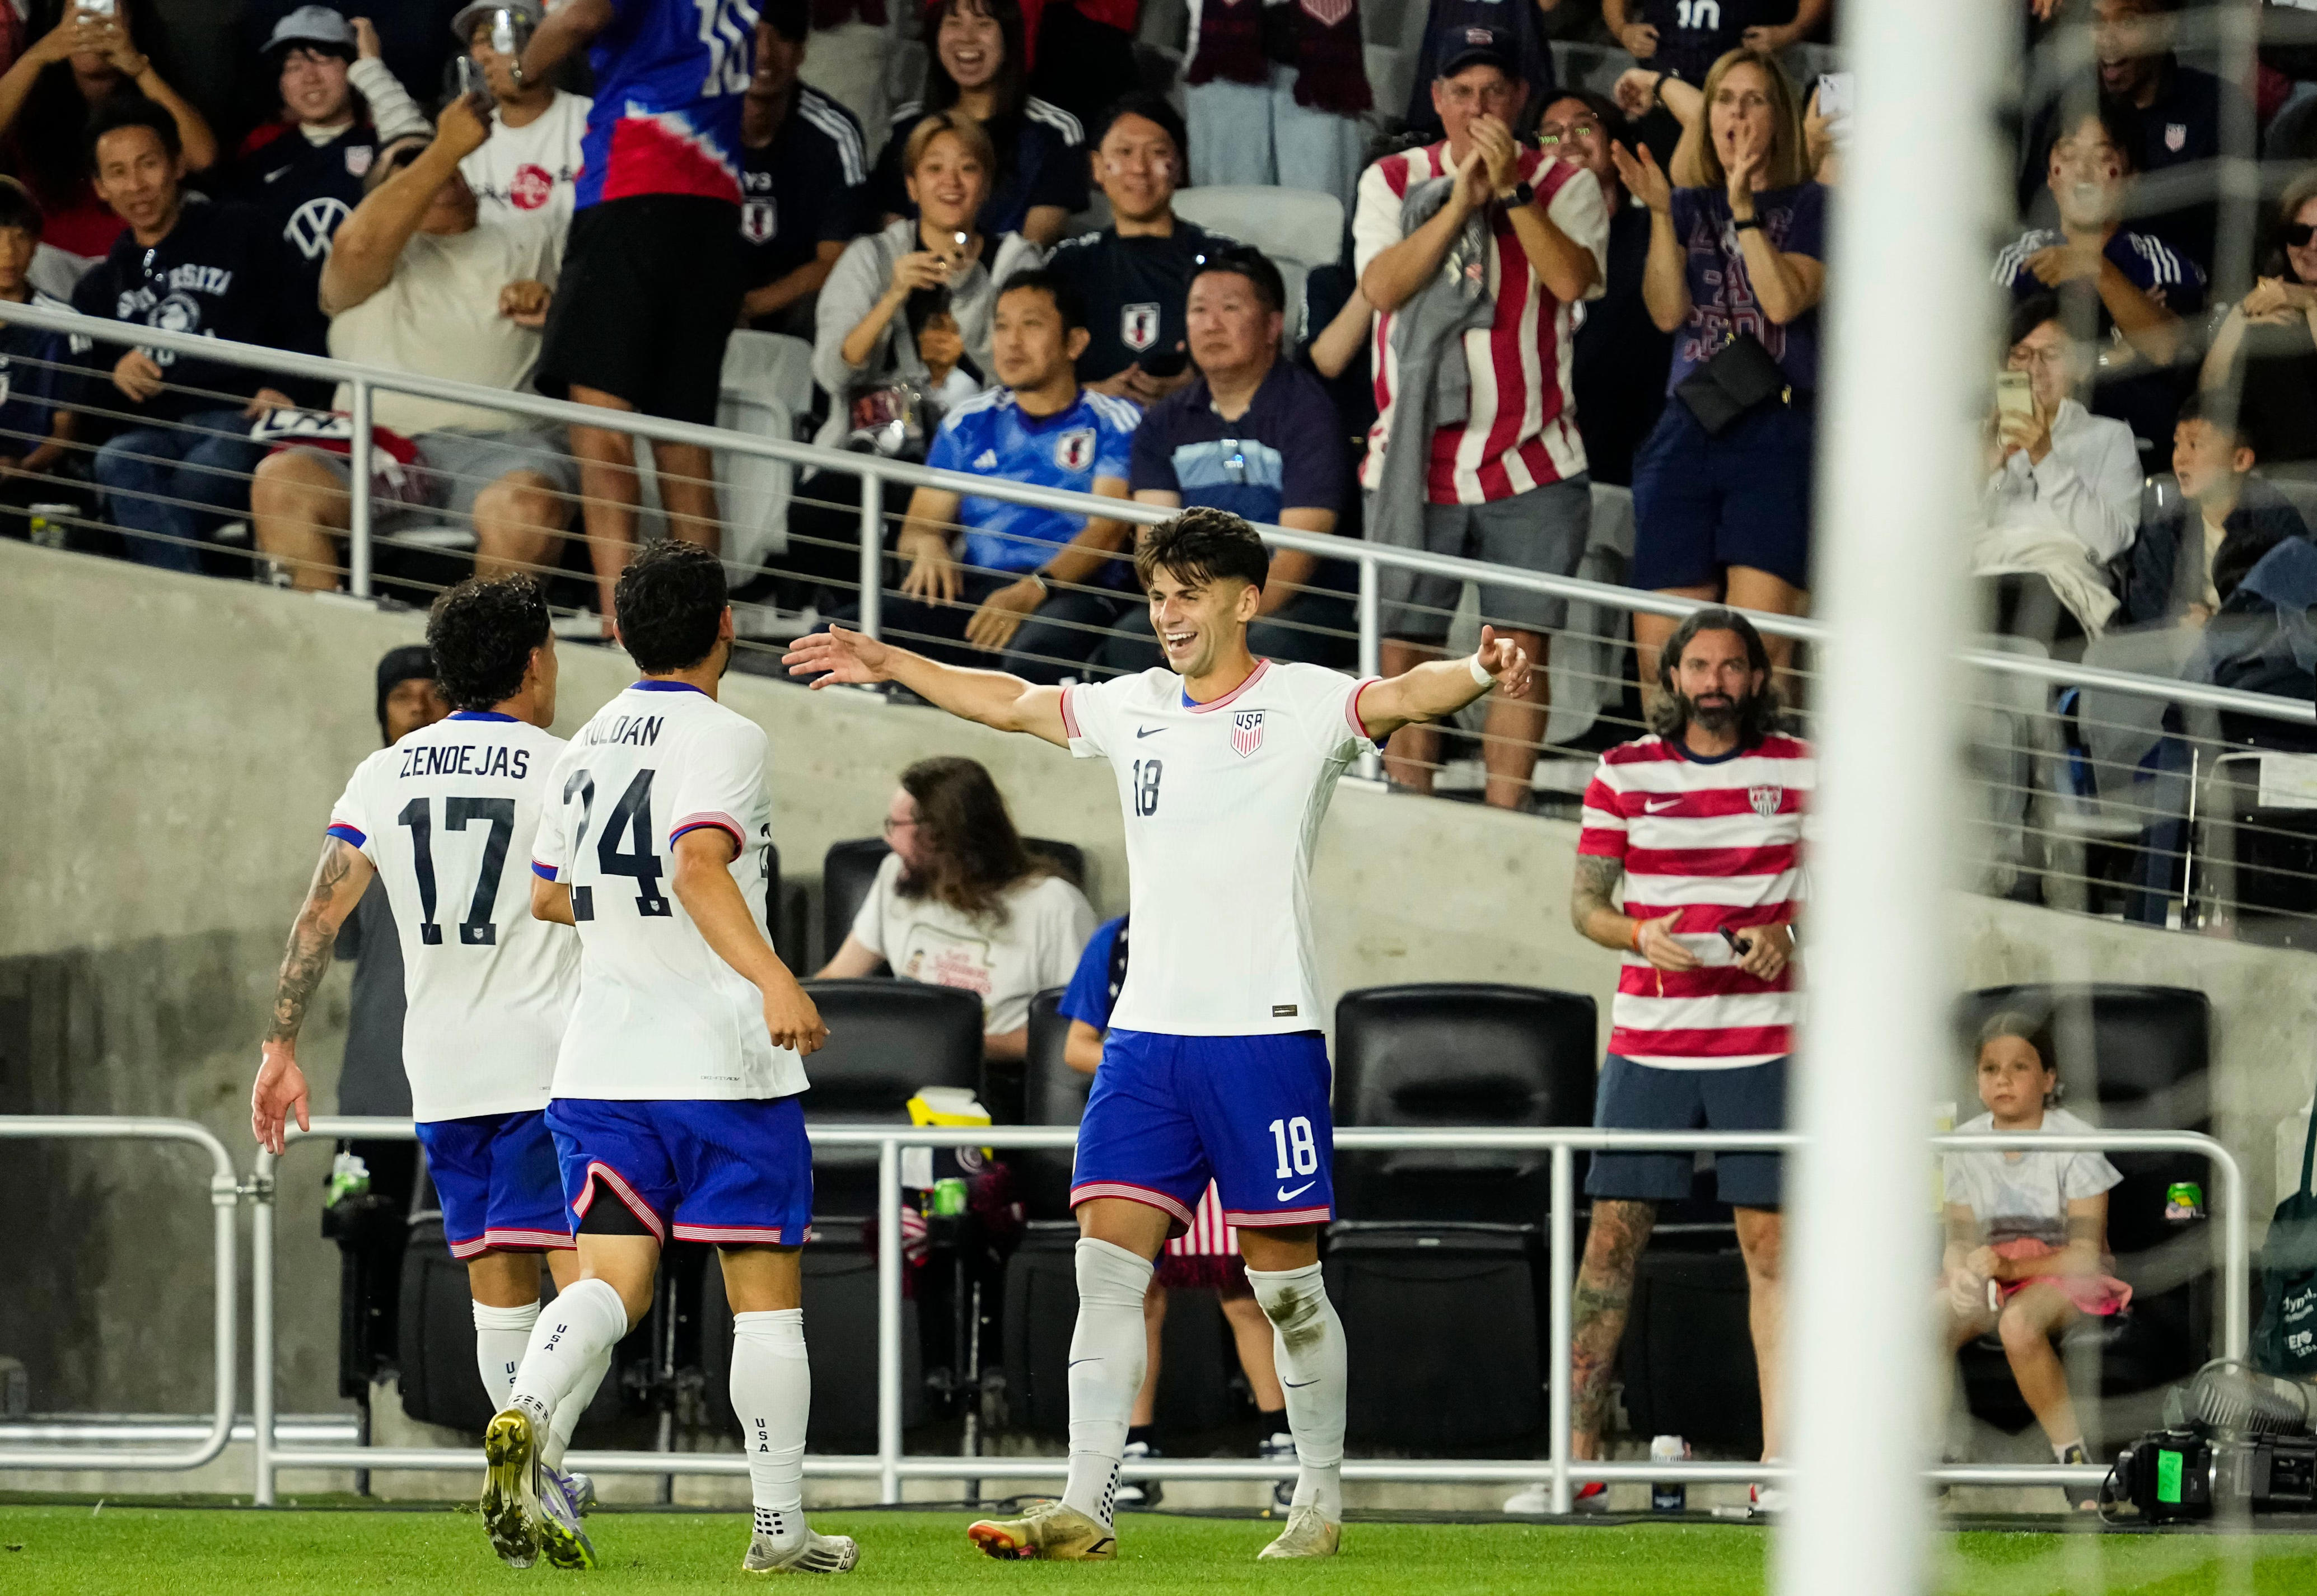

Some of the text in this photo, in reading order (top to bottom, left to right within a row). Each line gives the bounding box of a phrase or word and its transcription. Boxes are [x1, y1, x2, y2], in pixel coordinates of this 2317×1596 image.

[1236, 713, 1262, 730] USA
[400, 746, 530, 779] ZENDEJAS
[1133, 759, 1163, 816] 18
[563, 769, 673, 922] 24
[398, 797, 516, 946] 17
[1269, 1116, 1318, 1179] 18
[544, 1324, 568, 1351] USA
[506, 1361, 516, 1388] US
[755, 1418, 769, 1452] USA
